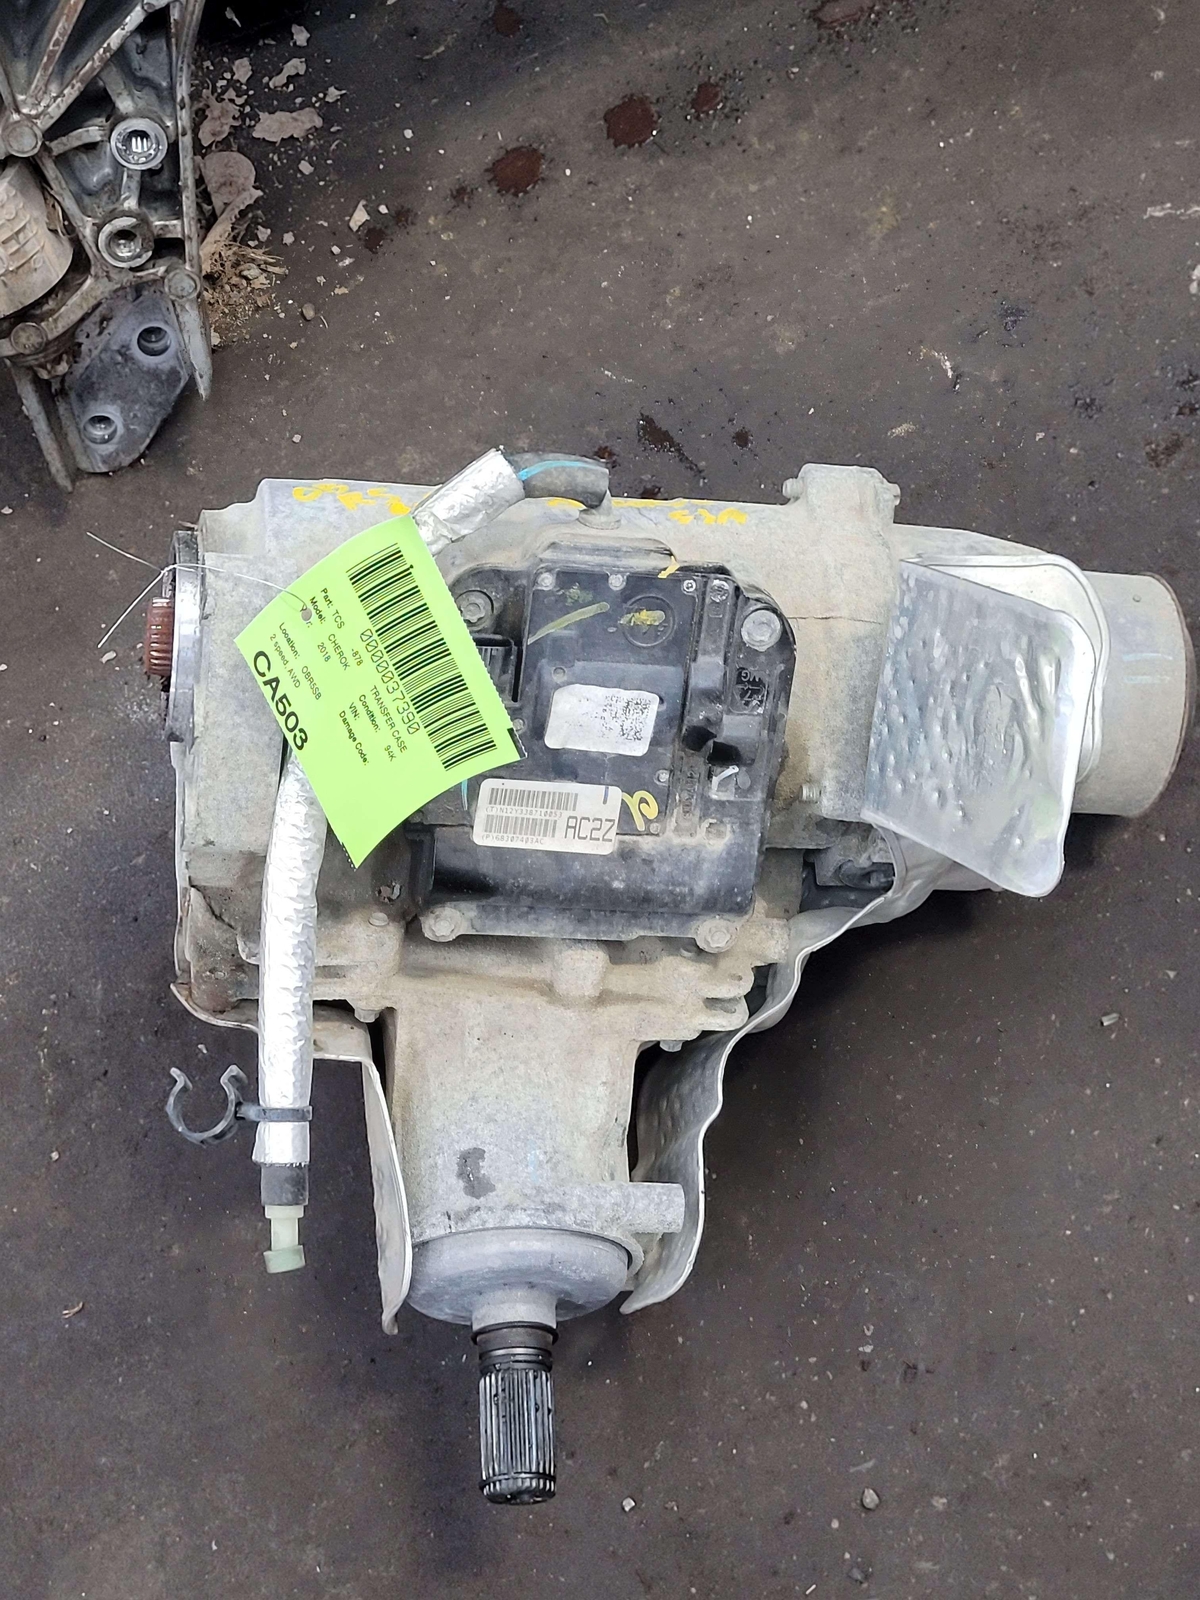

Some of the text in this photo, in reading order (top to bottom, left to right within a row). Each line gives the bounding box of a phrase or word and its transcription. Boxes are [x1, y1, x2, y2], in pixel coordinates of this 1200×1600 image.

[268, 632, 277, 641] 2
[286, 667, 301, 689] AWD
[277, 621, 300, 659] Location:
[298, 603, 331, 662] Yr: 2018
[308, 595, 350, 671] Model: CHEROK
[319, 587, 333, 608] Part:
[331, 608, 345, 629] TCS
[368, 684, 396, 731] TRANSFER
[390, 728, 407, 753] CASE
[358, 627, 421, 736] 0000037390
[253, 650, 309, 751] CA503
[347, 701, 360, 721] VIN:
[357, 693, 396, 762] Condition: 94K
[337, 709, 370, 766] Damage Code:
[564, 815, 616, 842] AC2Z
